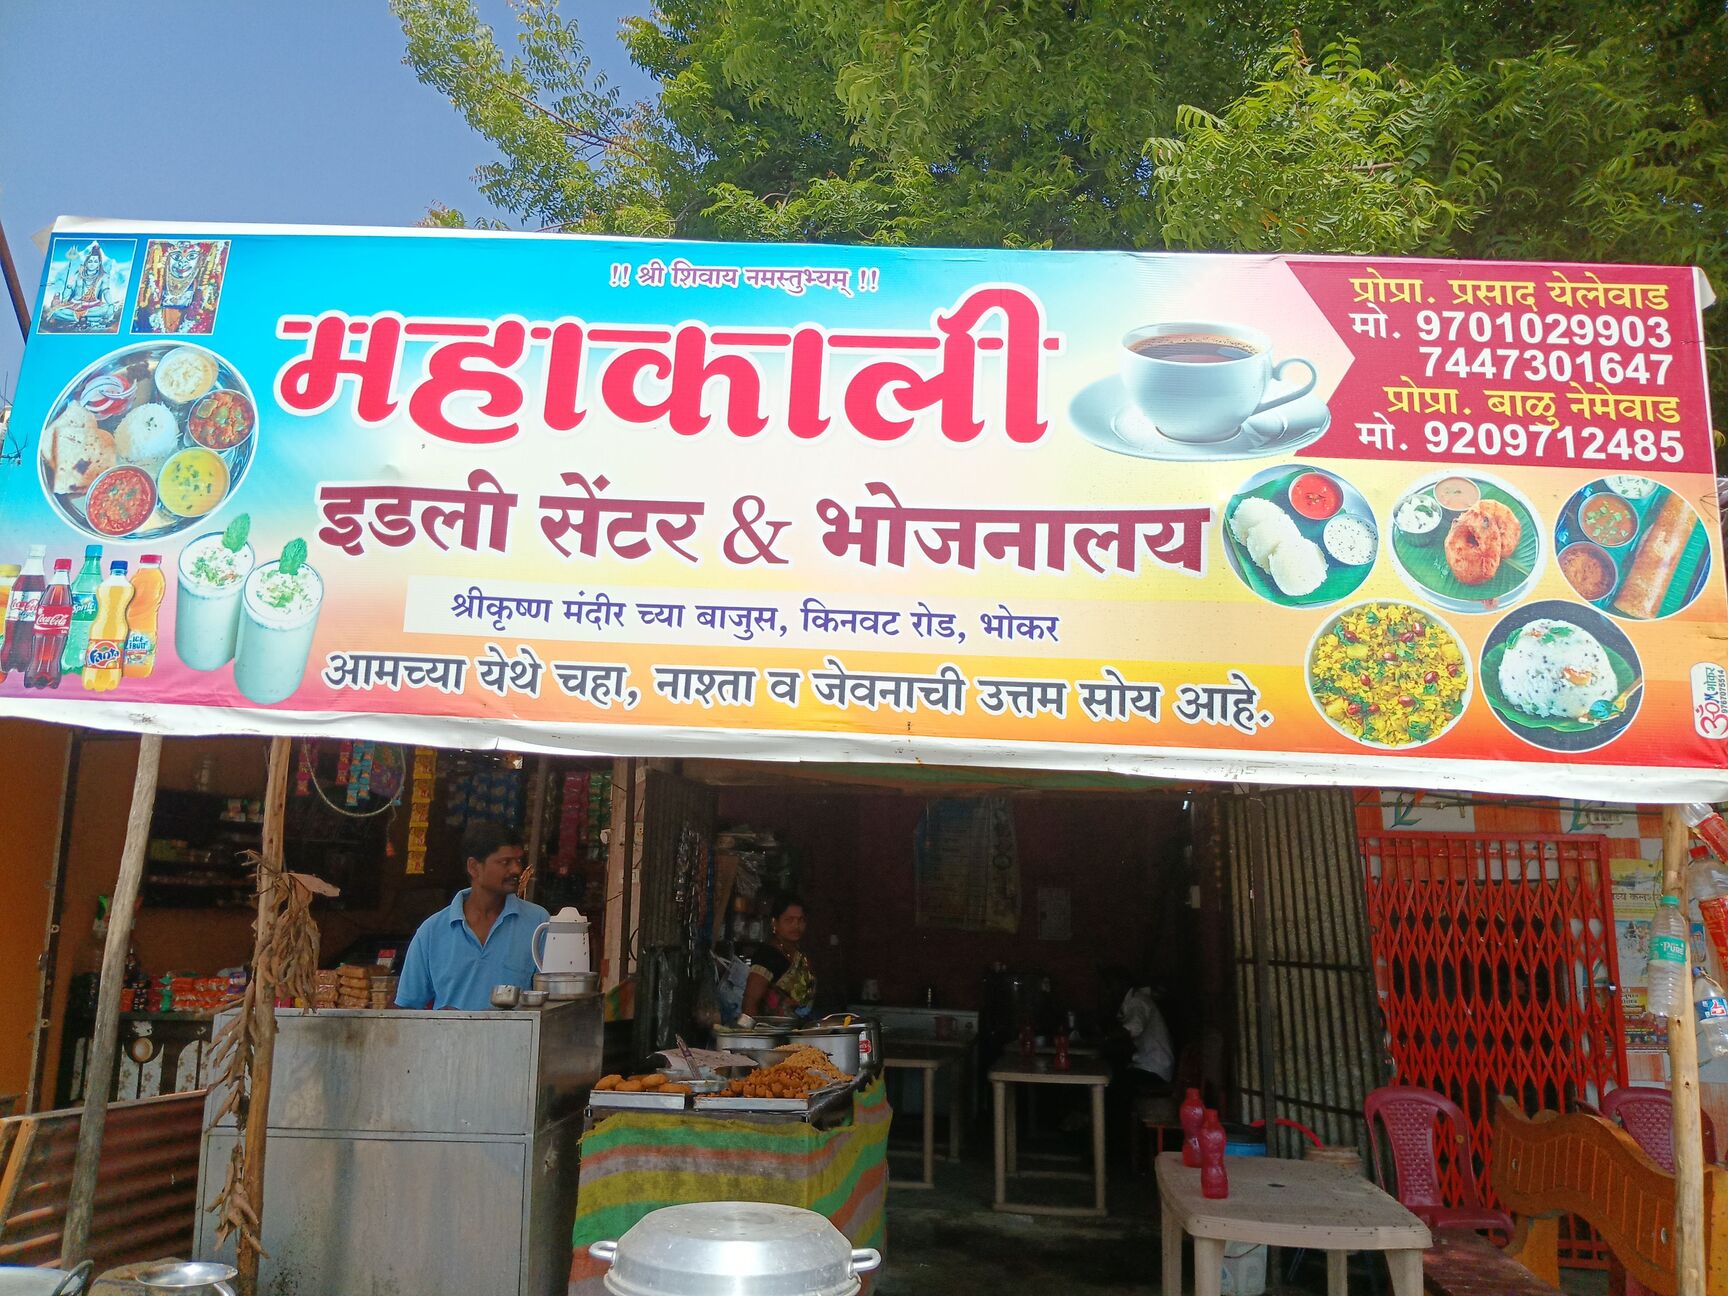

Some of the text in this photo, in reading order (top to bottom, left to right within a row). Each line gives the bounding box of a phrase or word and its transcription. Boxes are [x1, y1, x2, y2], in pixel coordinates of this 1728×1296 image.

[637, 261, 663, 285] श्री
[671, 261, 738, 288] शिवाय
[744, 267, 850, 297] नमस्तुभ्यम्
[1349, 267, 1669, 311] प्रोप्रा. प्रसाद येलेवाड
[1349, 303, 1672, 348] मो. 9701029903
[280, 288, 1060, 444] महाकाली
[1419, 346, 1673, 385] 7447301647
[1382, 376, 1681, 430] प्रोप्रा. बाळु नेमेवाड
[1354, 412, 1684, 463] मो. 9209712485
[319, 470, 1211, 573] इडली सेंटर & भोजनालय
[450, 586, 1060, 644] श्रीकृष्ण मंदीर च्या बाजुस, किनवट रोड, भोकर
[89, 647, 119, 665] Fanta
[325, 645, 1271, 732] आमच्या येथे चहा, नाश्ता व जेवनाची उत्तम सोय आहे.
